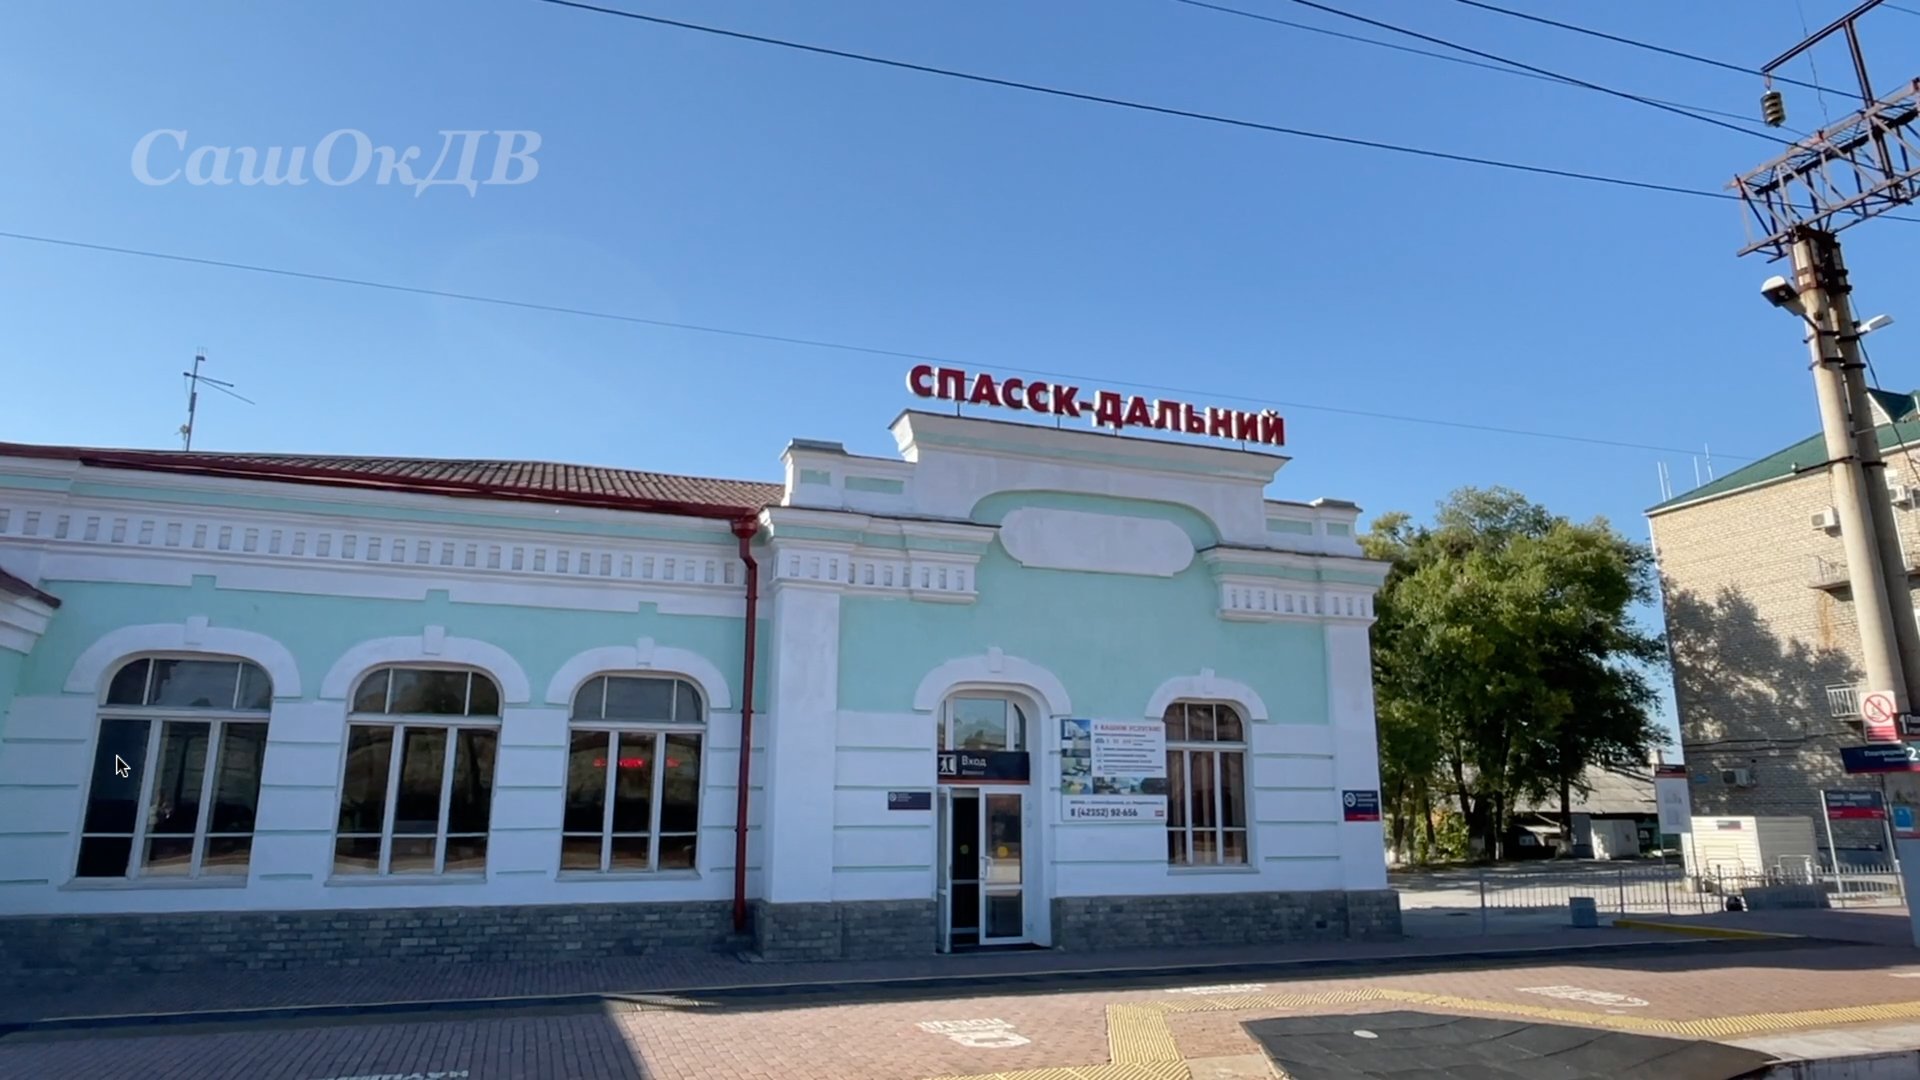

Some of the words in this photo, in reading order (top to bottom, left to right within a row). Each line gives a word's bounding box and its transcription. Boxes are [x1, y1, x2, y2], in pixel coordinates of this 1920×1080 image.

[906, 364, 1285, 446] СПАССК-ДАЛЬНИЙ
[961, 754, 987, 767] Вход
[1906, 746, 1920, 761] 2
